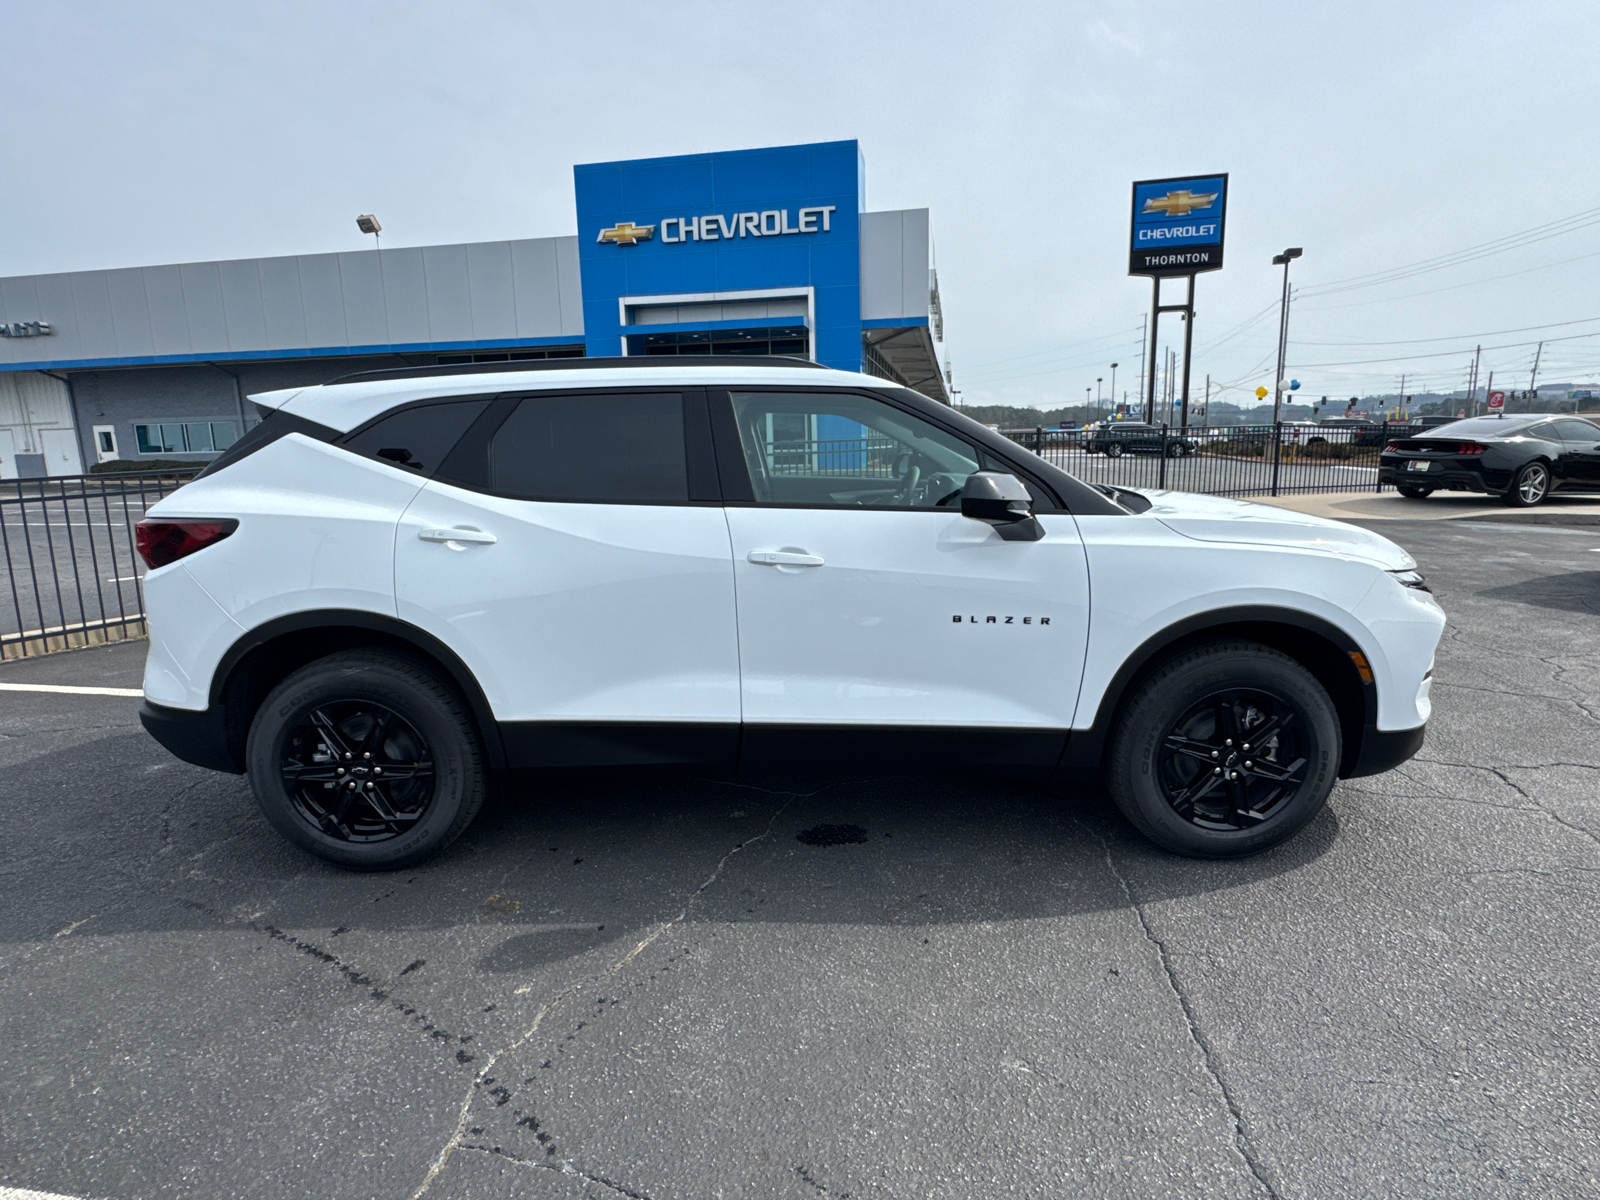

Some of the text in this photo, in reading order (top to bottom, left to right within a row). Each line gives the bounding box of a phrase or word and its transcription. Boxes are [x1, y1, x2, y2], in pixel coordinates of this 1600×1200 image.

[660, 205, 836, 243] CHEVROLET
[1138, 224, 1216, 240] CHEVROLET
[1144, 252, 1209, 266] THORNTON
[0, 321, 44, 338] ARTS
[952, 614, 1051, 626] BLAZER
